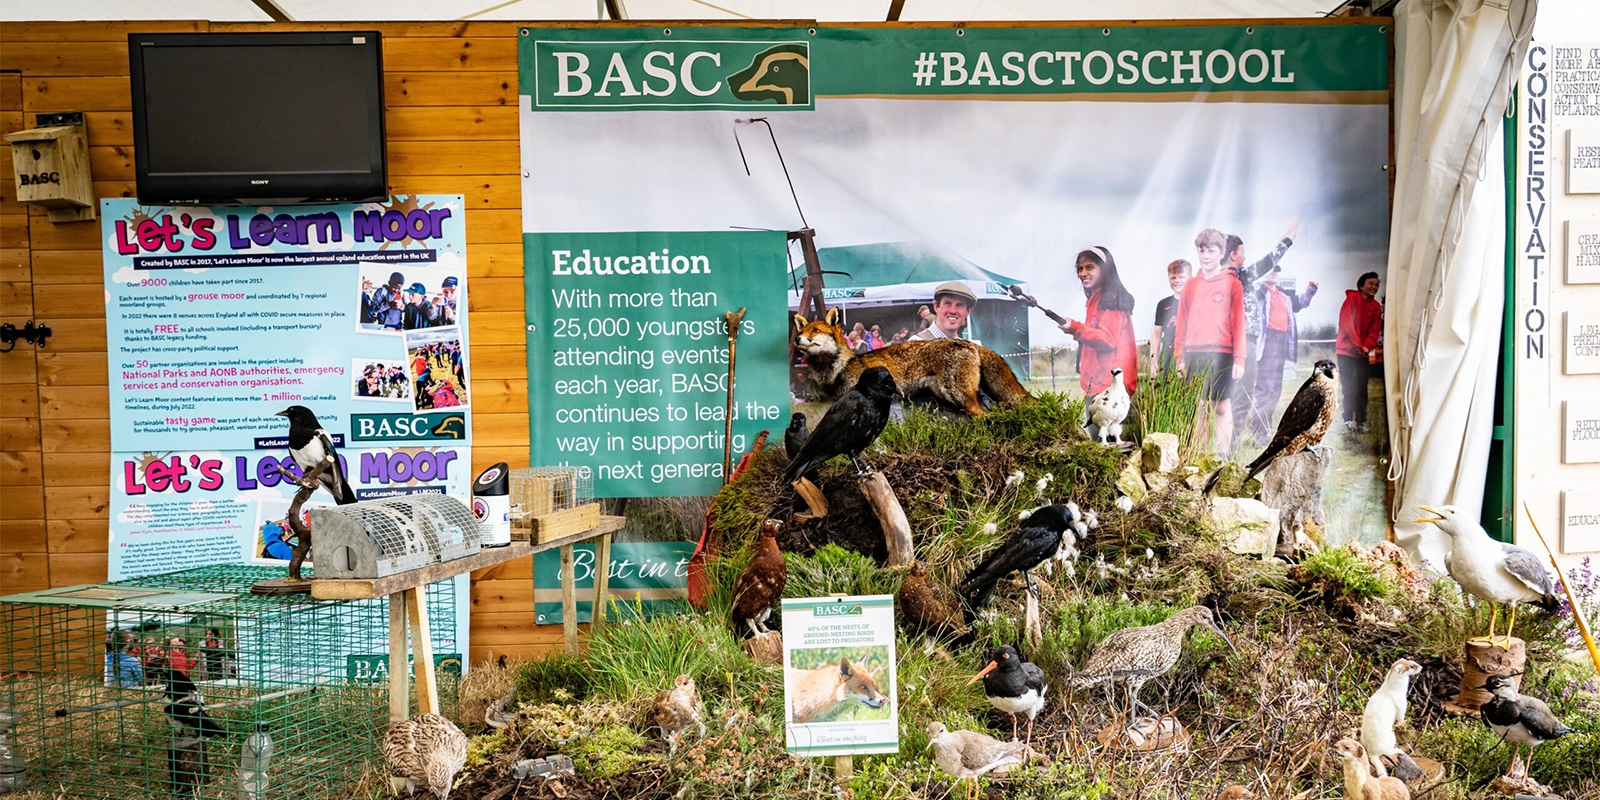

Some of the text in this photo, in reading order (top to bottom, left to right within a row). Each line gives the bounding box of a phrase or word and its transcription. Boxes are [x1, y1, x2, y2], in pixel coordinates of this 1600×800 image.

[1556, 48, 1582, 58] FIND
[913, 48, 1294, 86] #BASCTOSCHOOL
[1556, 59, 1582, 69] MORE
[554, 50, 724, 97] BASC
[1554, 94, 1588, 105] ACTION
[20, 172, 60, 185] BASC
[1525, 46, 1548, 359] CONSERVATION
[115, 213, 217, 256] Let's
[227, 211, 342, 250] Learn
[1578, 234, 1600, 245] CRE
[197, 258, 213, 266] 2017,
[336, 254, 355, 263] upland
[552, 248, 712, 276] Education
[141, 278, 167, 287] 9000
[188, 293, 218, 302] grouse
[552, 288, 717, 308] With more than
[825, 289, 852, 298] BASC
[154, 324, 179, 334] FREE
[554, 317, 630, 340] 25,000
[1580, 325, 1600, 335] LEG
[1573, 336, 1600, 346] PRED
[136, 360, 148, 368] 50
[554, 346, 730, 369] attending events
[123, 365, 344, 380] National Parks and AONB authorities, emergency
[123, 377, 304, 390] services and conservation organisations.
[555, 373, 736, 398] each year, BASC
[271, 392, 301, 401] million
[556, 400, 780, 424] continues to lead the
[166, 417, 216, 426] tasty game
[358, 417, 428, 437] BASC
[556, 437, 600, 456] way
[607, 432, 625, 451] in
[124, 455, 223, 496] Let's
[598, 462, 643, 479] next
[651, 460, 736, 483] generai
[557, 549, 636, 581] Bst
[639, 559, 669, 578] in
[816, 605, 847, 615] BASC
[803, 631, 856, 639] GROUND-NESTING
